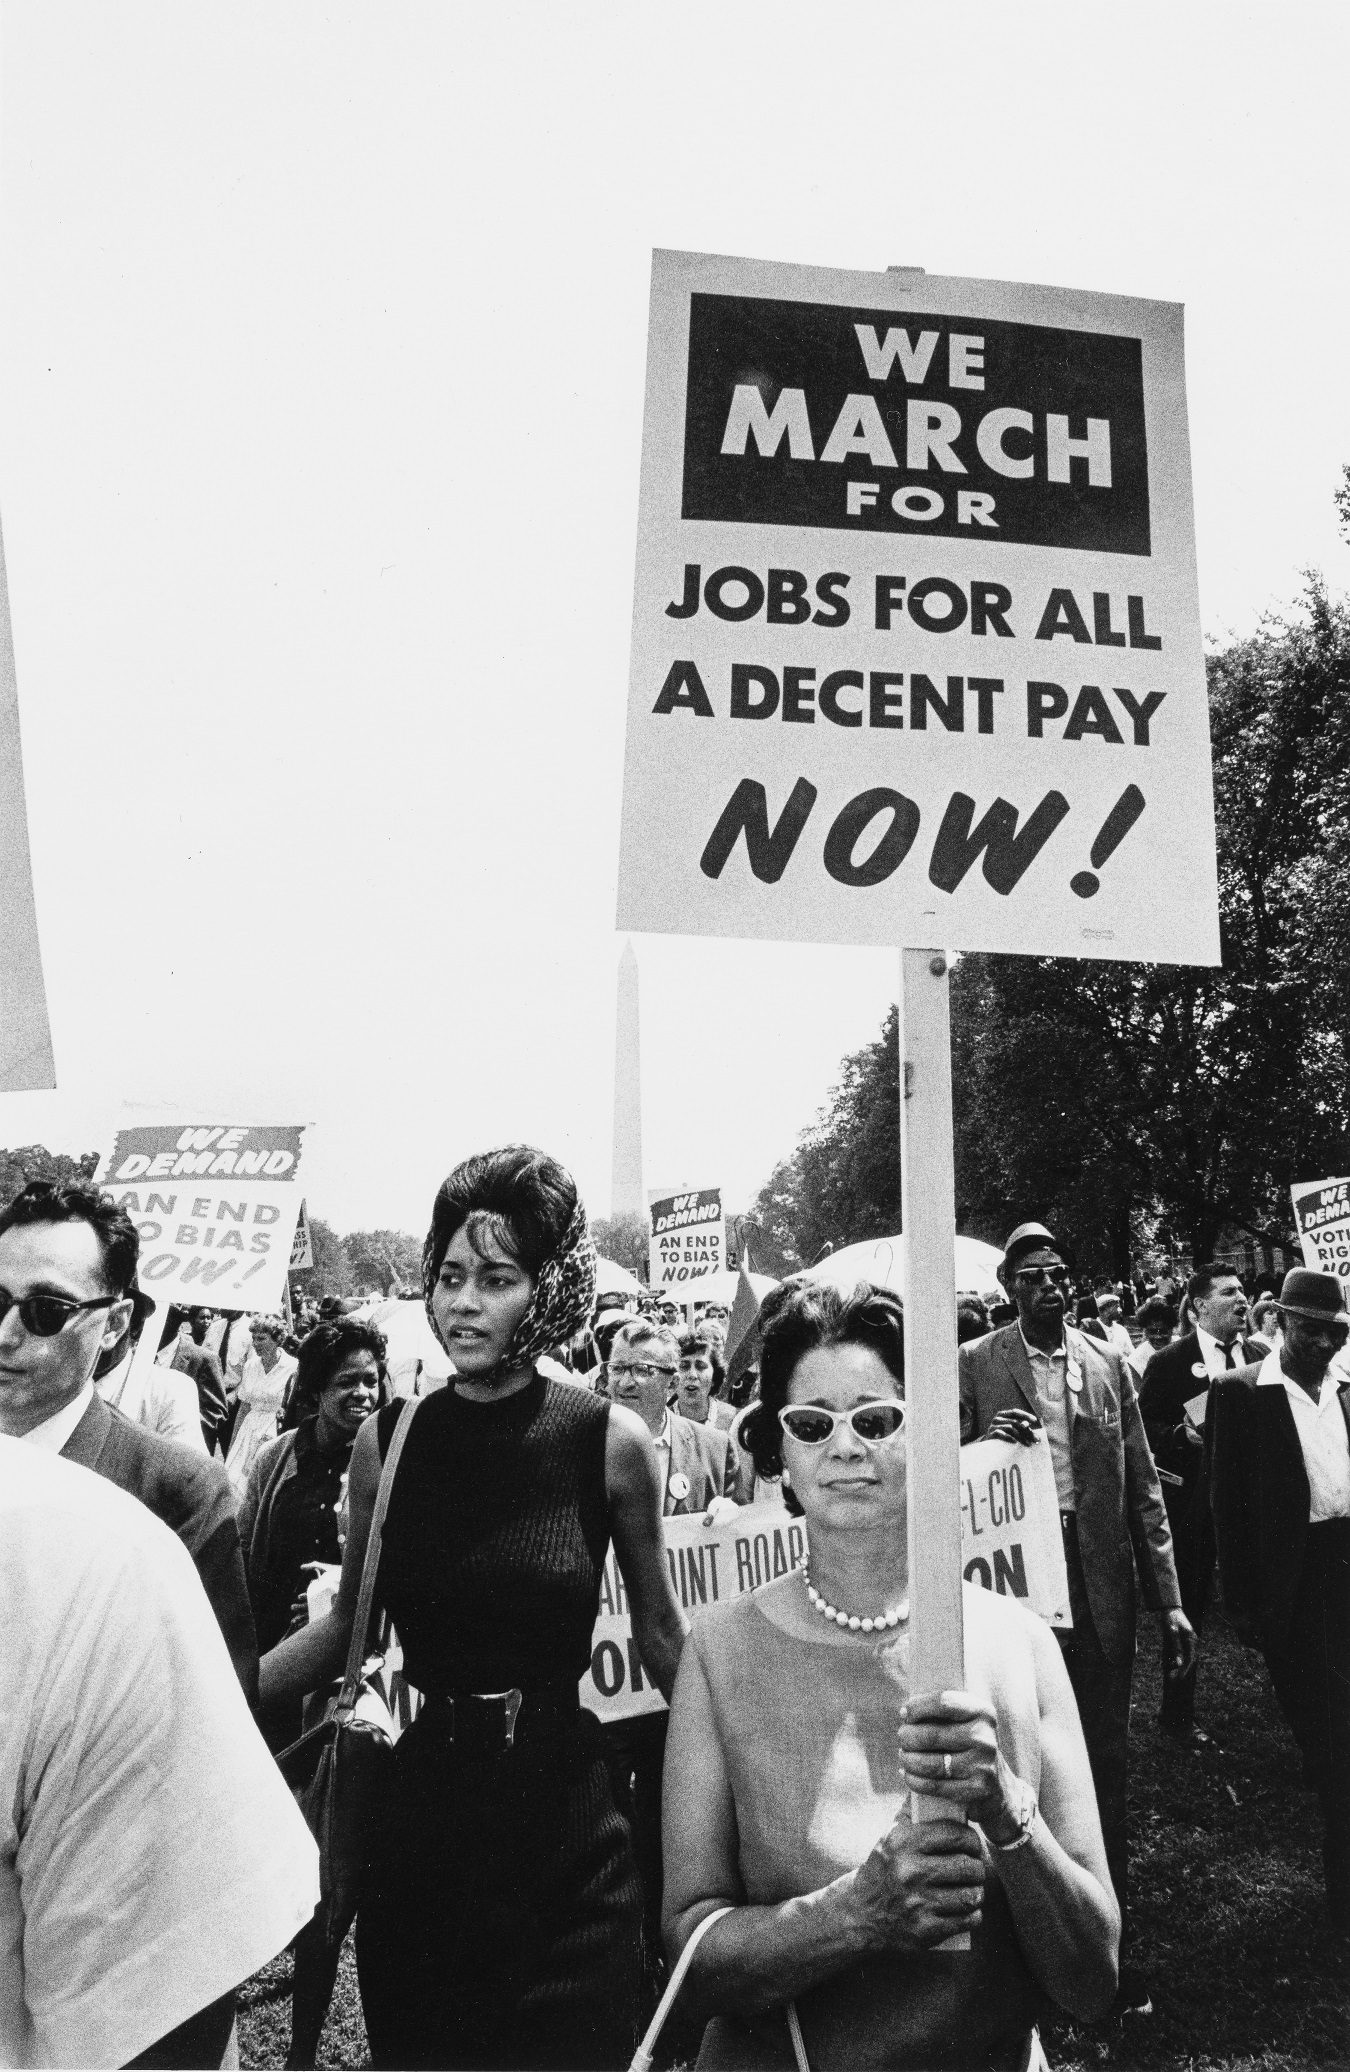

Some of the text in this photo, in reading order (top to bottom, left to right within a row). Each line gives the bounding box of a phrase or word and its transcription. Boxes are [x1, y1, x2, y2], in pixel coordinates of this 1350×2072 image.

[854, 323, 986, 391] WE
[720, 385, 1113, 488] MARCH
[846, 482, 1000, 527] FOR
[665, 564, 1163, 651] JOBS FOR ALL
[651, 660, 1167, 747] A DECENT PAY
[699, 777, 1147, 899] NOW!
[176, 1127, 250, 1151] WE
[115, 1150, 295, 1180] DEMAND
[118, 1191, 281, 1225] AN END
[673, 1192, 700, 1212] WE
[1320, 1184, 1348, 1206] WE
[655, 1203, 720, 1233] DEMAND
[174, 1224, 272, 1254] BIAS
[659, 1235, 720, 1248] AN END
[139, 1253, 267, 1290] OW!
[660, 1250, 719, 1264] TO BIAS
[661, 1263, 720, 1282] NOW!
